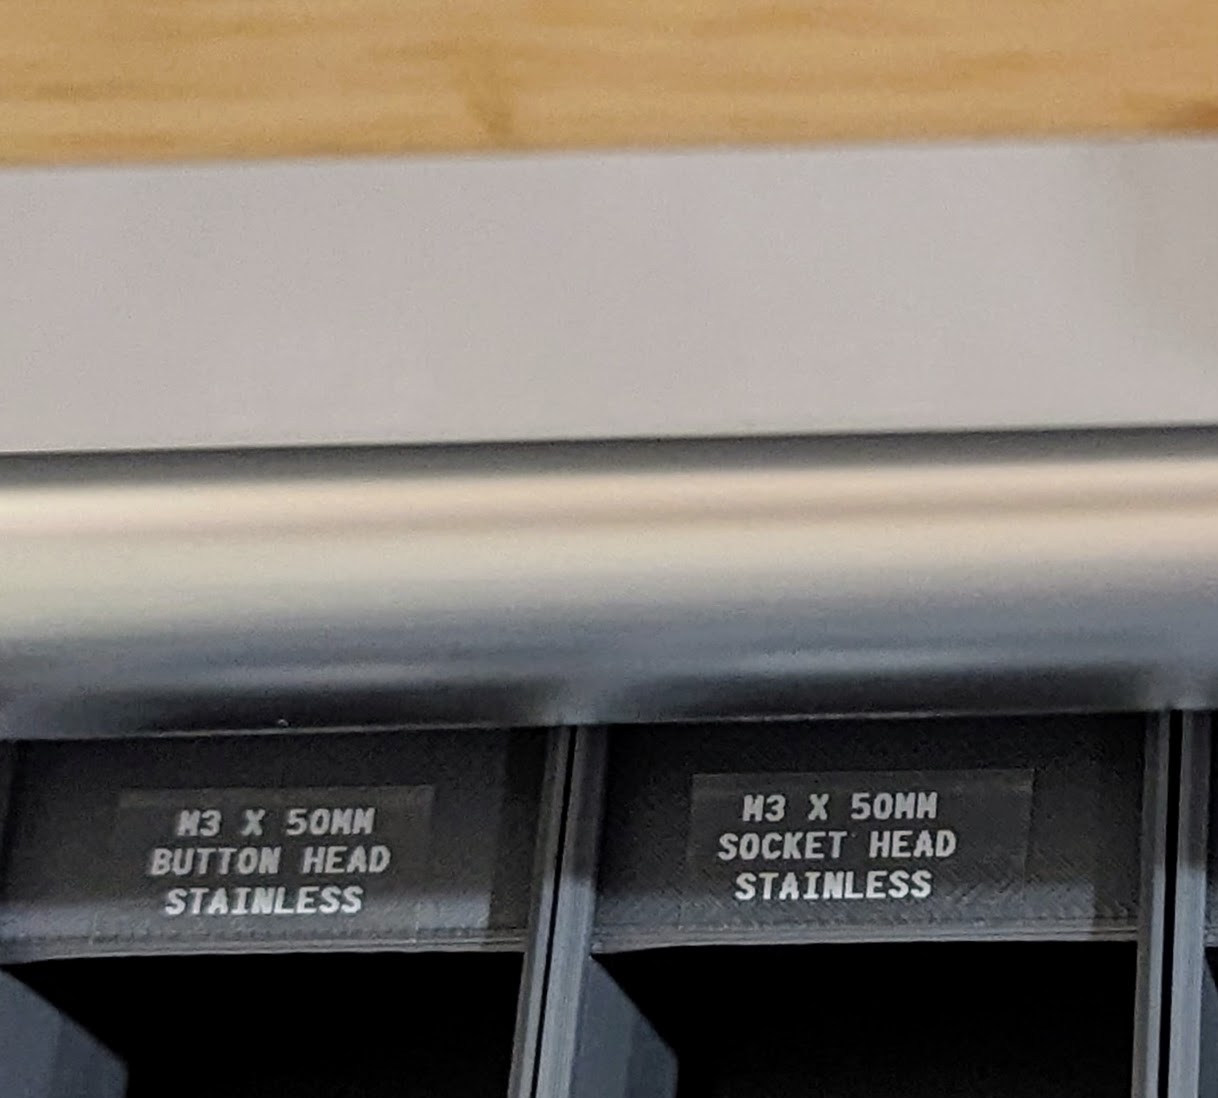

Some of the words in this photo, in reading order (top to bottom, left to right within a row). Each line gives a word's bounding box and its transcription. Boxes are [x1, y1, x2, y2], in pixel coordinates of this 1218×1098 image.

[176, 809, 222, 836] M3
[240, 809, 266, 836] X
[286, 808, 375, 836] 50MM
[742, 794, 786, 822] M3
[808, 794, 829, 820] X
[850, 792, 938, 820] 50MM
[718, 831, 848, 860] SOCKET
[869, 830, 956, 858] HEAD
[150, 846, 282, 876] BUTTON
[302, 845, 391, 874] HEAD
[734, 870, 932, 900] STAINLESS
[164, 886, 364, 915] STAINLESS
